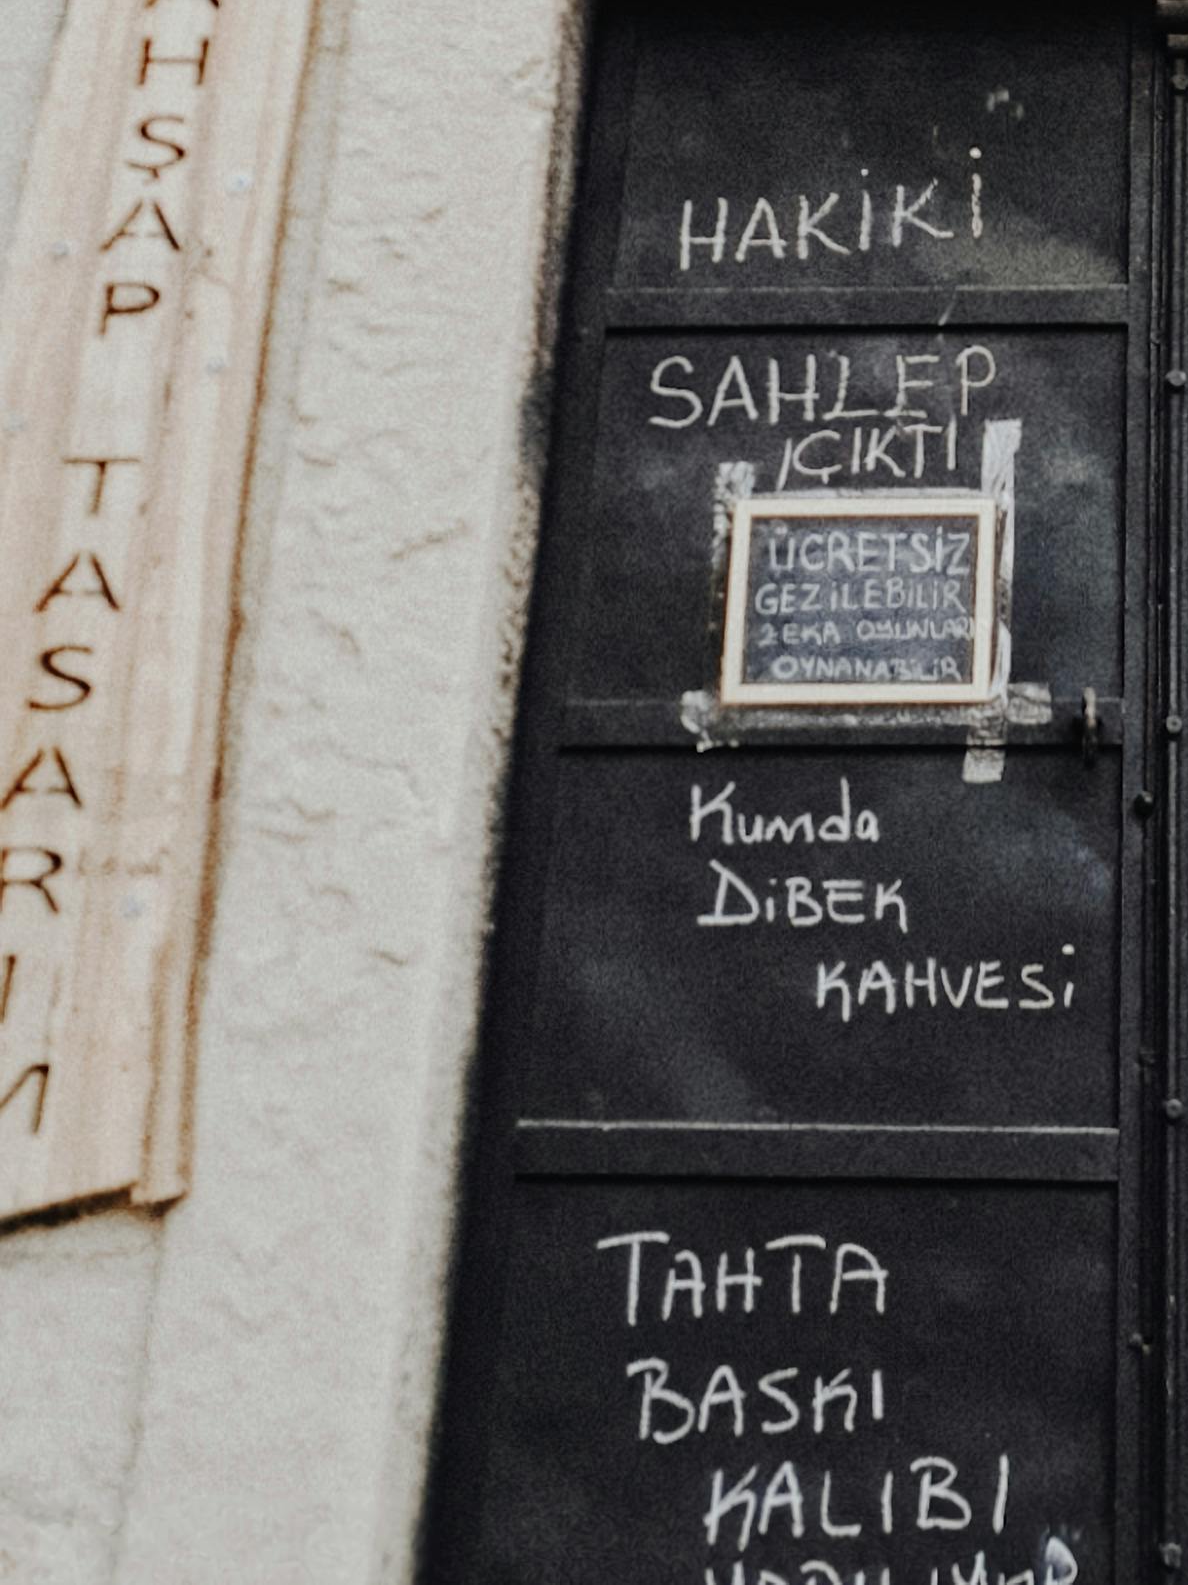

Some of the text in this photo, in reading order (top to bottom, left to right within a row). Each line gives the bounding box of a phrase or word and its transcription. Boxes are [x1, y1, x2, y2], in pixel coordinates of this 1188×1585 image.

[649, 345, 997, 429] SAHLEP
[690, 775, 880, 845] Kumda
[597, 1231, 889, 1326] TAHTA
[626, 1356, 883, 1444] BASKI
[703, 1453, 1009, 1552] KALIBI
